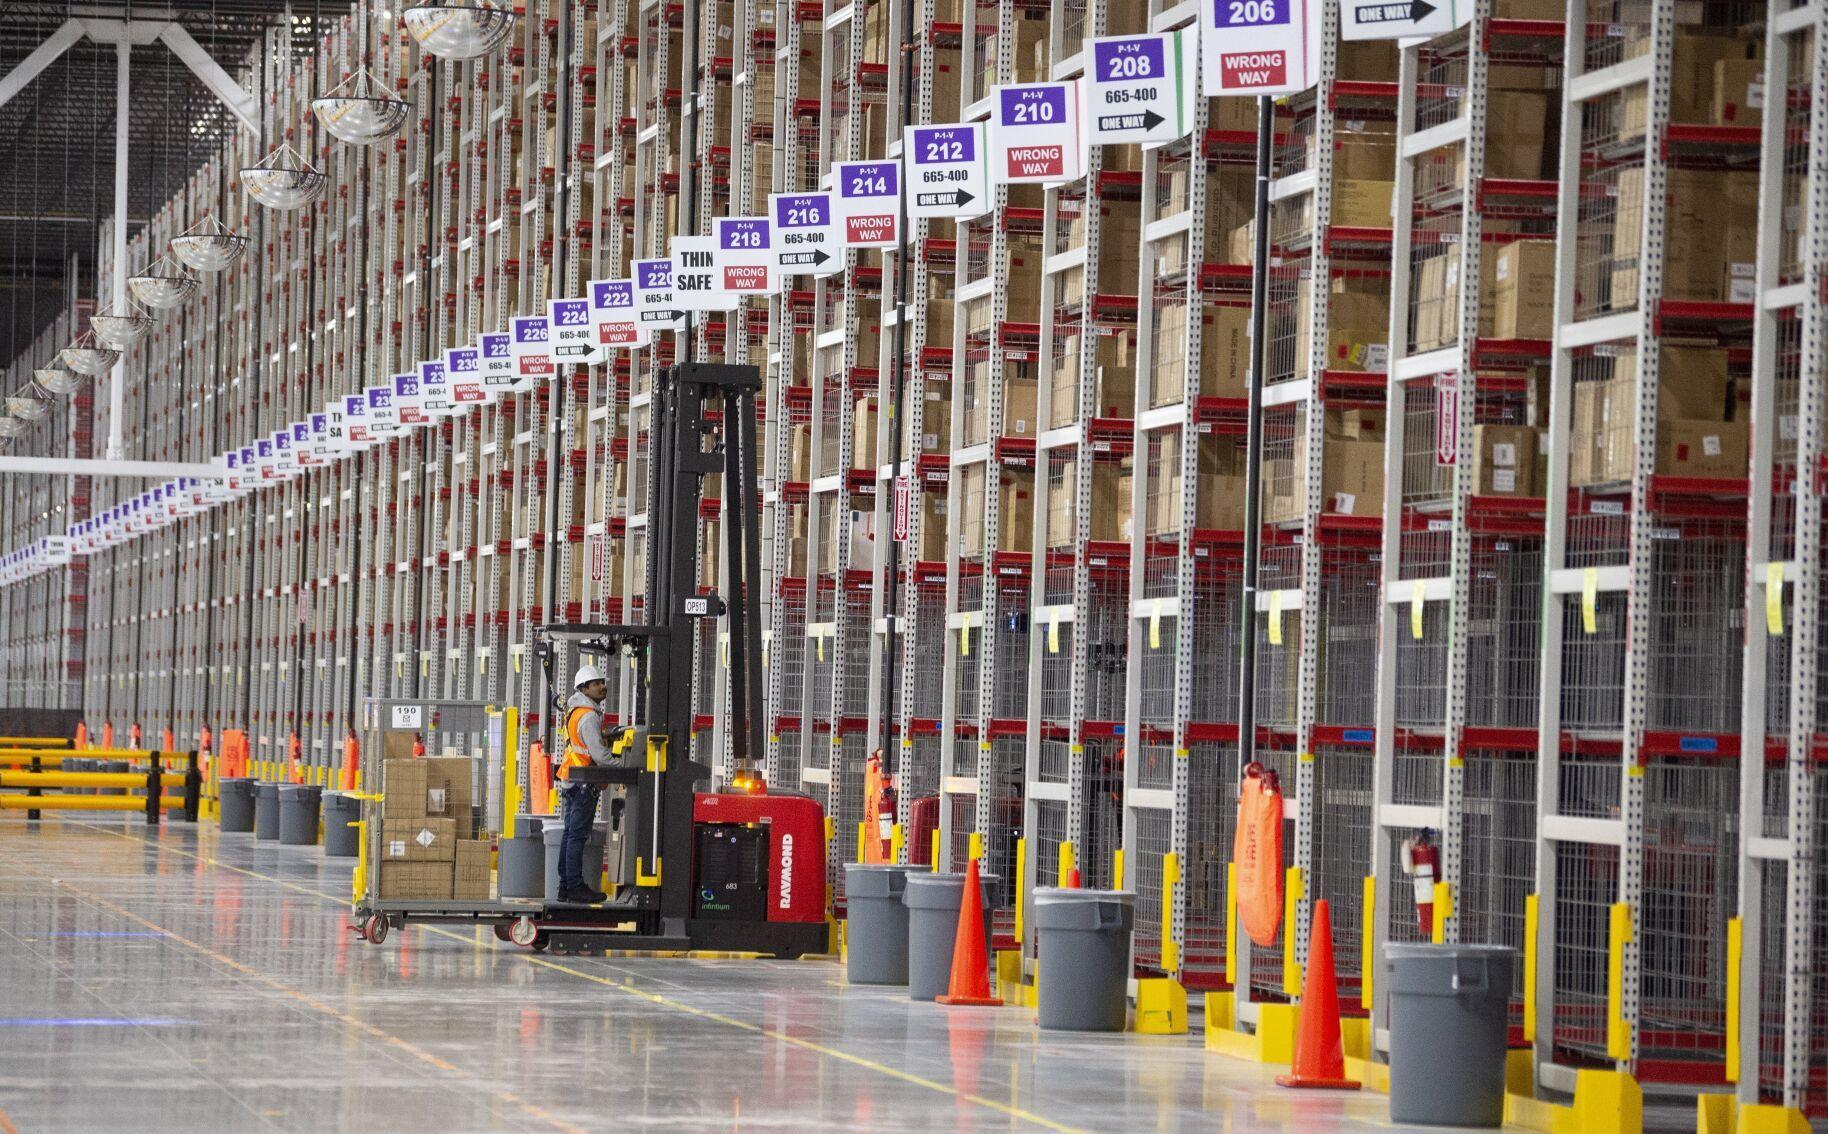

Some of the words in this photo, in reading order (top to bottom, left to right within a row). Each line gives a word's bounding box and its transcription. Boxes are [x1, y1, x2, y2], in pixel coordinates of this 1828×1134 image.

[1229, 0, 1276, 23] 206
[1359, 7, 1382, 22] ONE
[1384, 5, 1411, 20] WAY
[1118, 44, 1140, 54] P-1-V
[1110, 56, 1151, 78] 208
[1226, 54, 1282, 70] WRONG
[1238, 70, 1270, 85] WAY
[1022, 92, 1044, 100] P-1-V
[1106, 88, 1157, 104] 665-400
[1014, 102, 1053, 122] 210
[1102, 116, 1120, 130] ONE
[1122, 115, 1144, 128] WAY
[934, 132, 954, 140] P-1-V
[926, 142, 963, 160] 212
[1012, 149, 1060, 162] WRONG
[1022, 162, 1049, 174] WAY
[923, 170, 968, 182] 665-400
[852, 178, 886, 195] 214
[920, 194, 935, 206] ONE
[936, 194, 957, 204] WAY
[788, 208, 819, 224] 216
[850, 218, 892, 228] WRONG
[730, 232, 761, 246] 218
[784, 232, 824, 244] 665-400
[860, 230, 883, 240] WAY
[681, 252, 713, 267] THIN
[782, 254, 796, 265] ONE
[797, 253, 814, 264] WAY
[727, 268, 764, 277] WRONG
[678, 274, 713, 290] SAFE
[736, 278, 756, 288] WAY
[604, 292, 629, 306] 222
[646, 294, 672, 303] 665-4
[562, 311, 587, 324] 224
[643, 312, 656, 320] ONE
[657, 311, 672, 319] WAY
[524, 328, 548, 340] 226
[602, 324, 634, 332] WRONG
[457, 359, 478, 370] 230
[430, 372, 444, 383] 23
[1440, 379, 1456, 387] FIRE
[403, 384, 418, 394] 23
[376, 396, 391, 406] 23
[687, 601, 706, 611] OP513
[780, 833, 793, 909] RAYMOND
